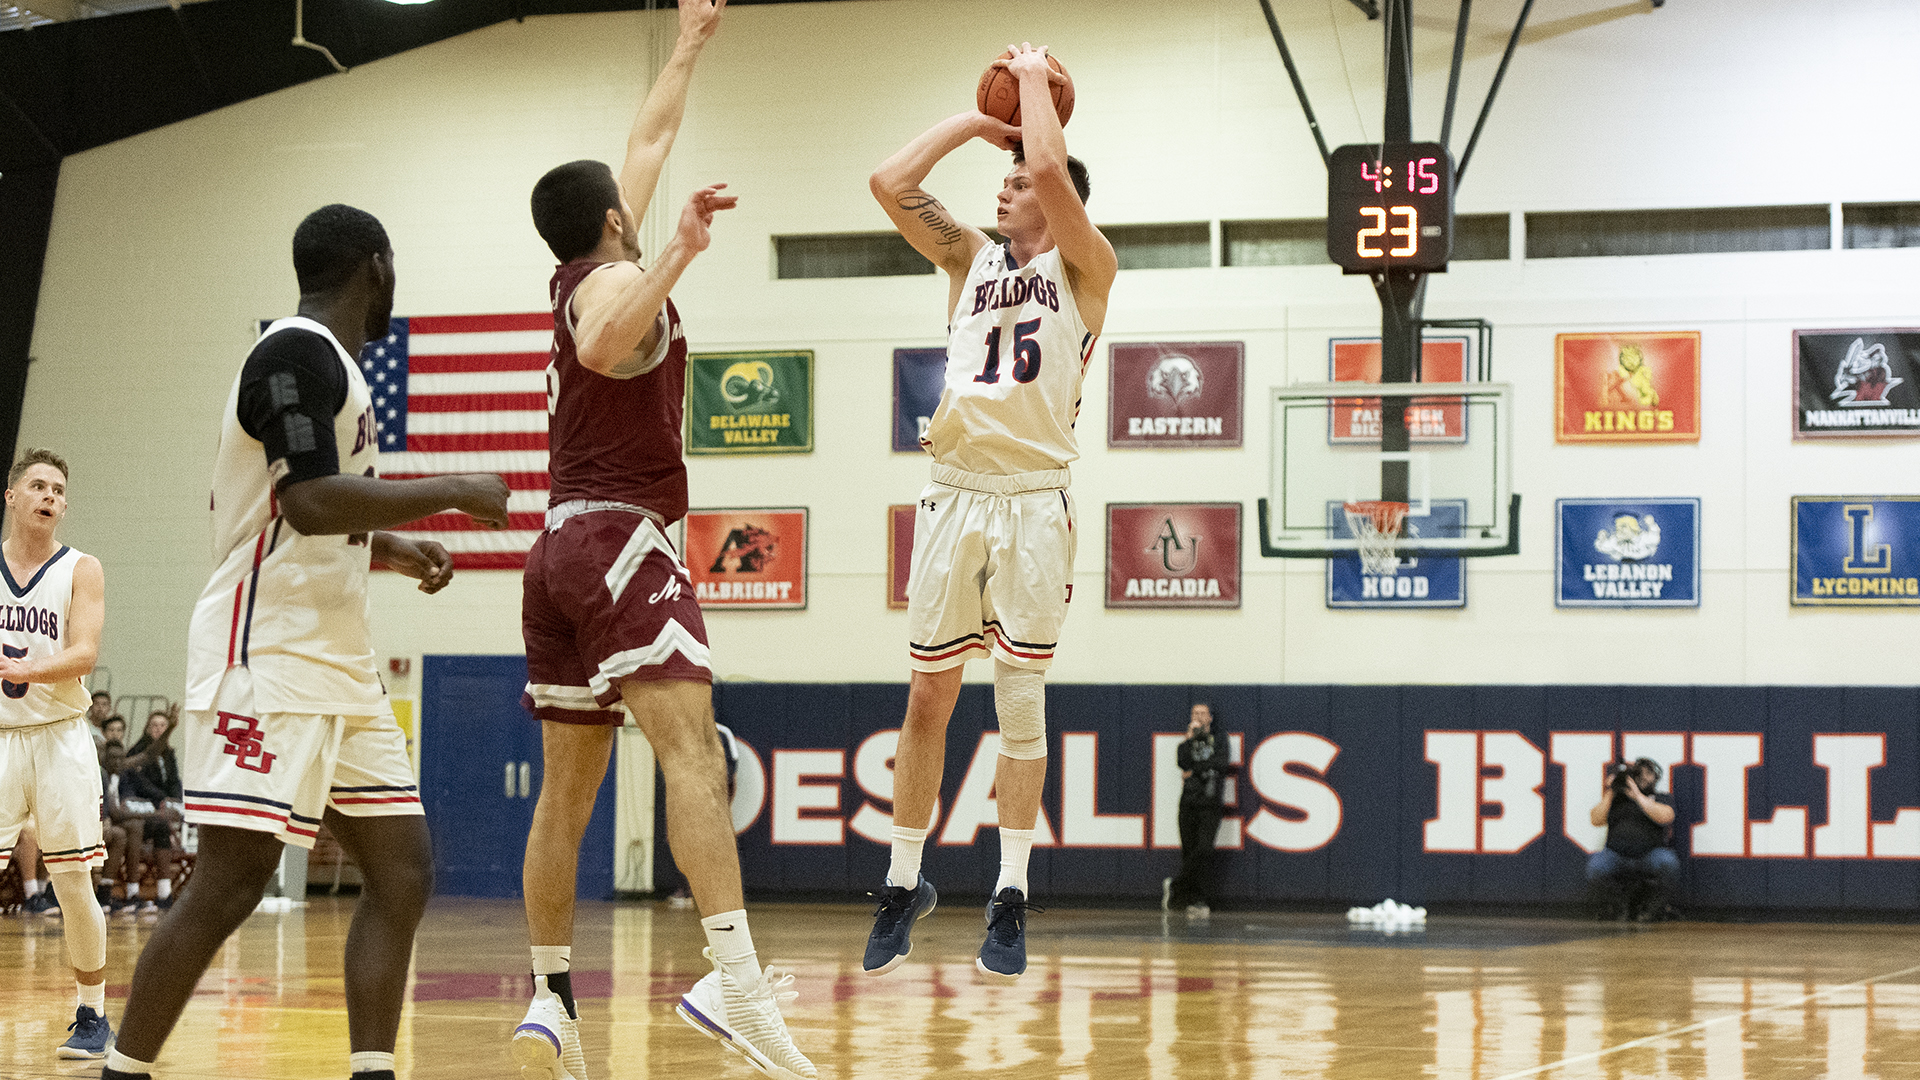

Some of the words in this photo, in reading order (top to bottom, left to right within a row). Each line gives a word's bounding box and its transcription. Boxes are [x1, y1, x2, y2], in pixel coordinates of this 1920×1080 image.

[1360, 157, 1439, 194] 4:15
[895, 189, 962, 250] Family
[1356, 205, 1418, 258] 23
[973, 317, 1042, 385] 15
[710, 413, 790, 430] DELAWARE
[1351, 409, 1444, 422] FAIIGH
[1584, 409, 1674, 432] KING'S
[1805, 409, 1920, 427] MANHATTANVILL
[1128, 417, 1223, 435] EASTERN
[1350, 422, 1446, 436] DICSON
[724, 429, 778, 444] VALLEY
[1584, 564, 1673, 581] LEBANON
[696, 581, 793, 599] ALBRIGHT
[1125, 578, 1221, 598] ARCADIA
[1362, 576, 1429, 598] HOOD
[1594, 581, 1663, 599] VALLEY
[1812, 578, 1919, 595] LYCOMING
